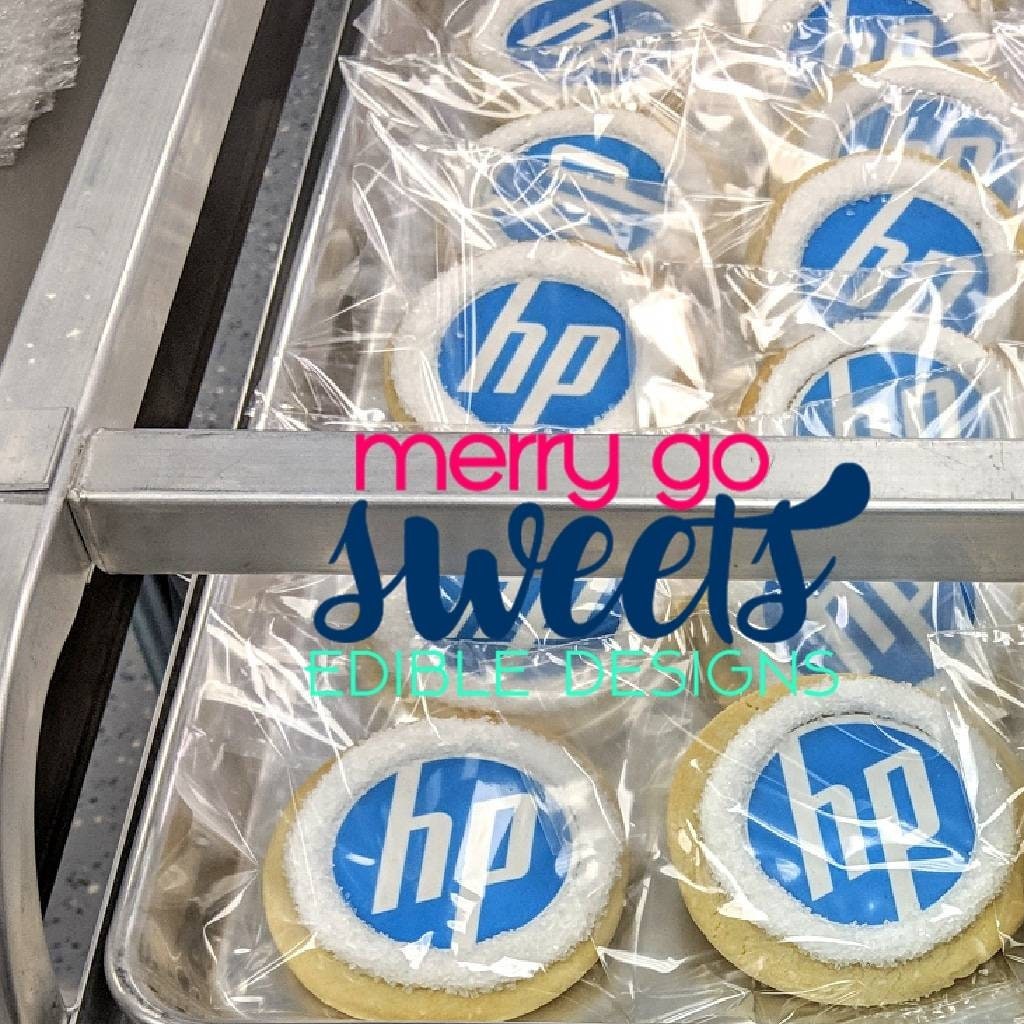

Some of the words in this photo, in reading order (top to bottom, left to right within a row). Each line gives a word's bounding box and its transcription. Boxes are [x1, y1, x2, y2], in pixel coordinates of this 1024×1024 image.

[457, 280, 620, 426] hp
[371, 760, 535, 948] hp
[778, 735, 940, 922] hp
